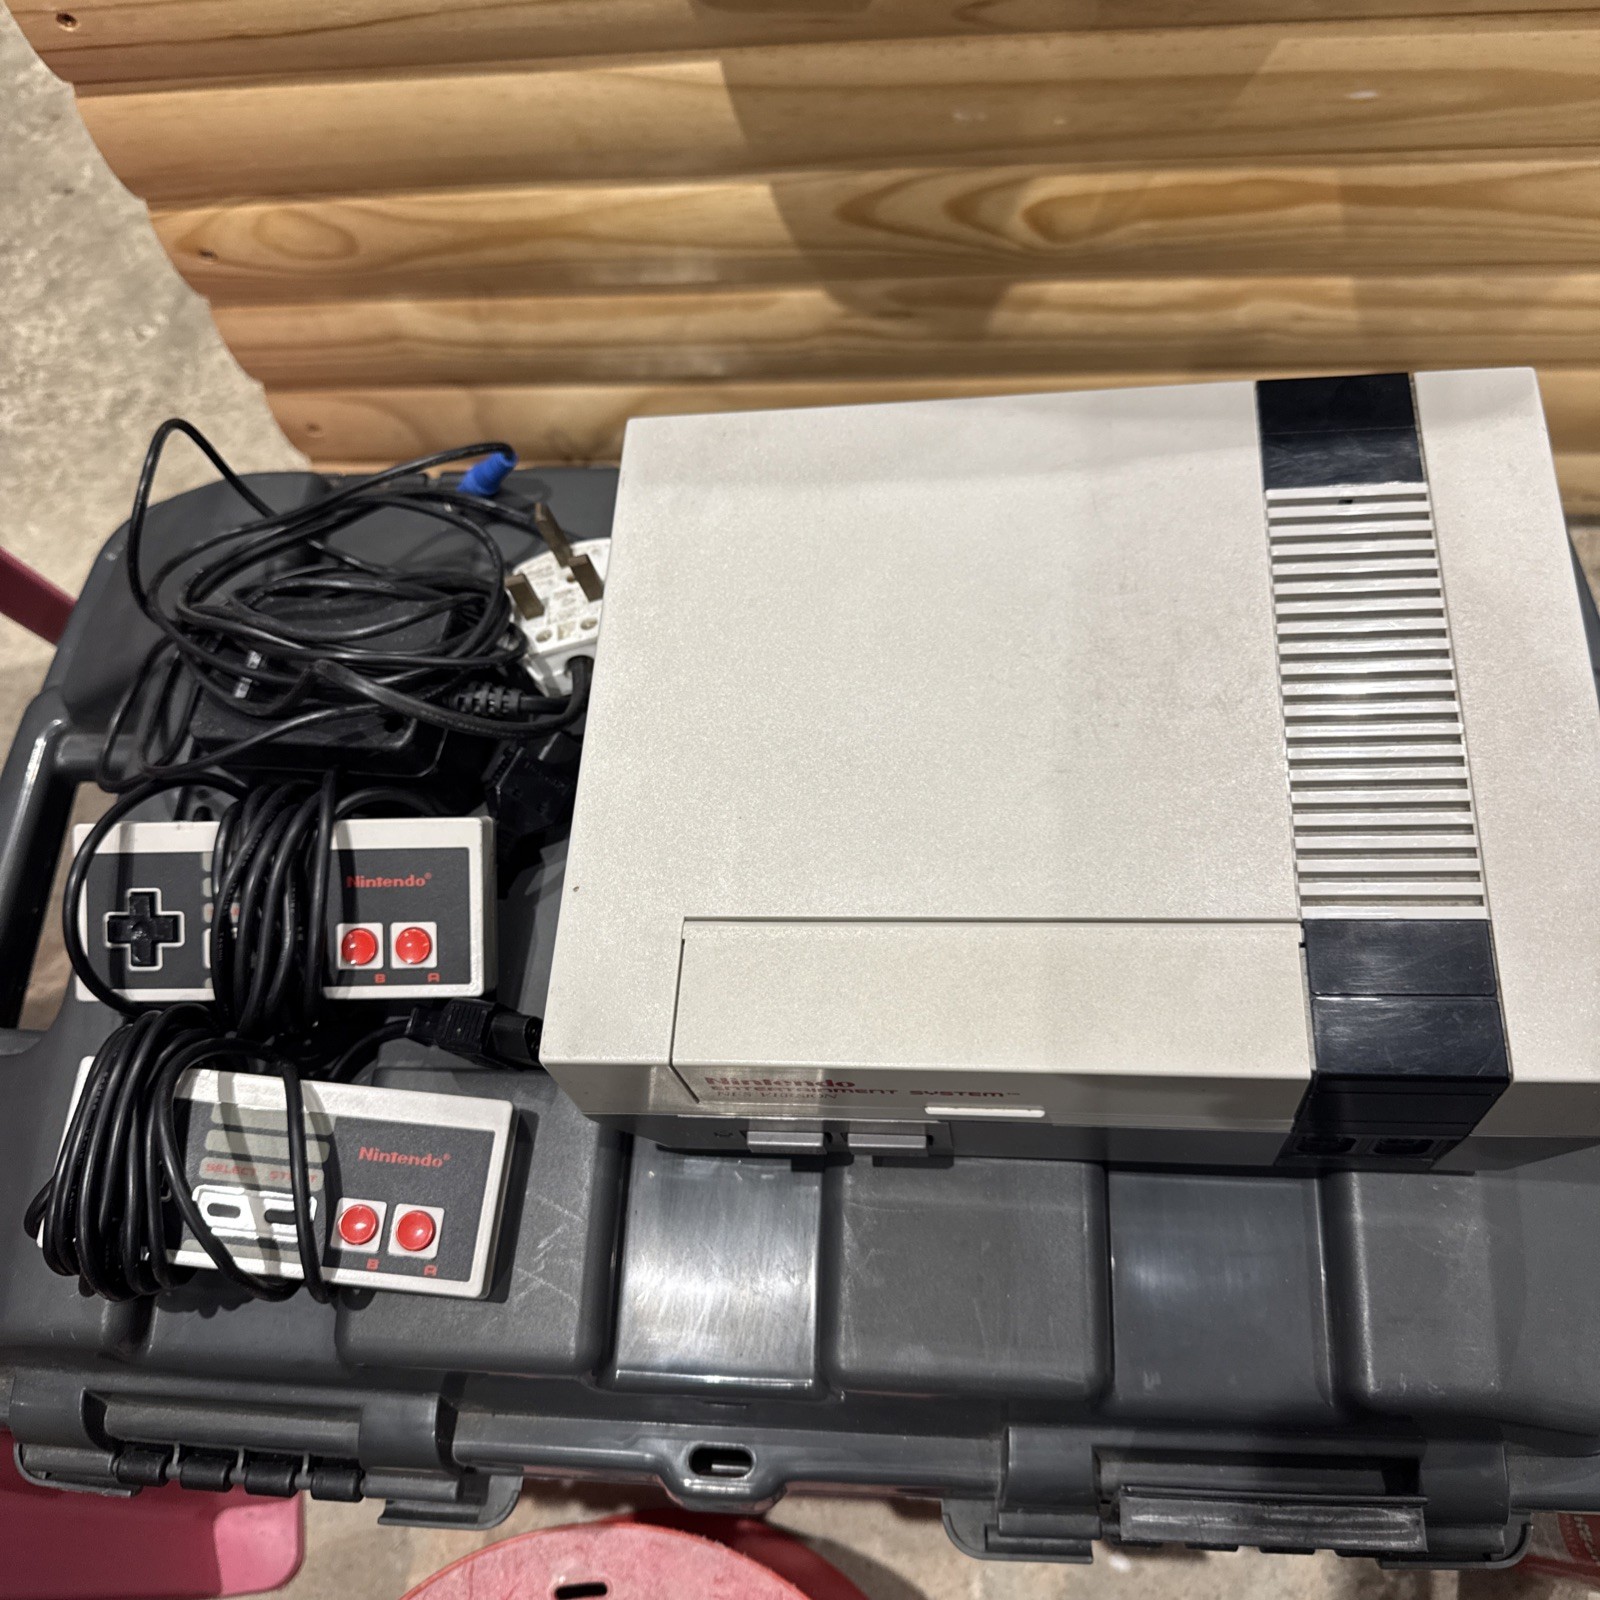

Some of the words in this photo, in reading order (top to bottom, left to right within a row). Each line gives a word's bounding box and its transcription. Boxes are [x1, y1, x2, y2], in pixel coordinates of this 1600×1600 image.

[374, 973, 386, 984] B
[427, 972, 440, 983] A
[704, 1077, 855, 1087] Nintendo
[206, 1163, 256, 1177] SELECT
[366, 1258, 379, 1270] B
[423, 1264, 437, 1276] A
